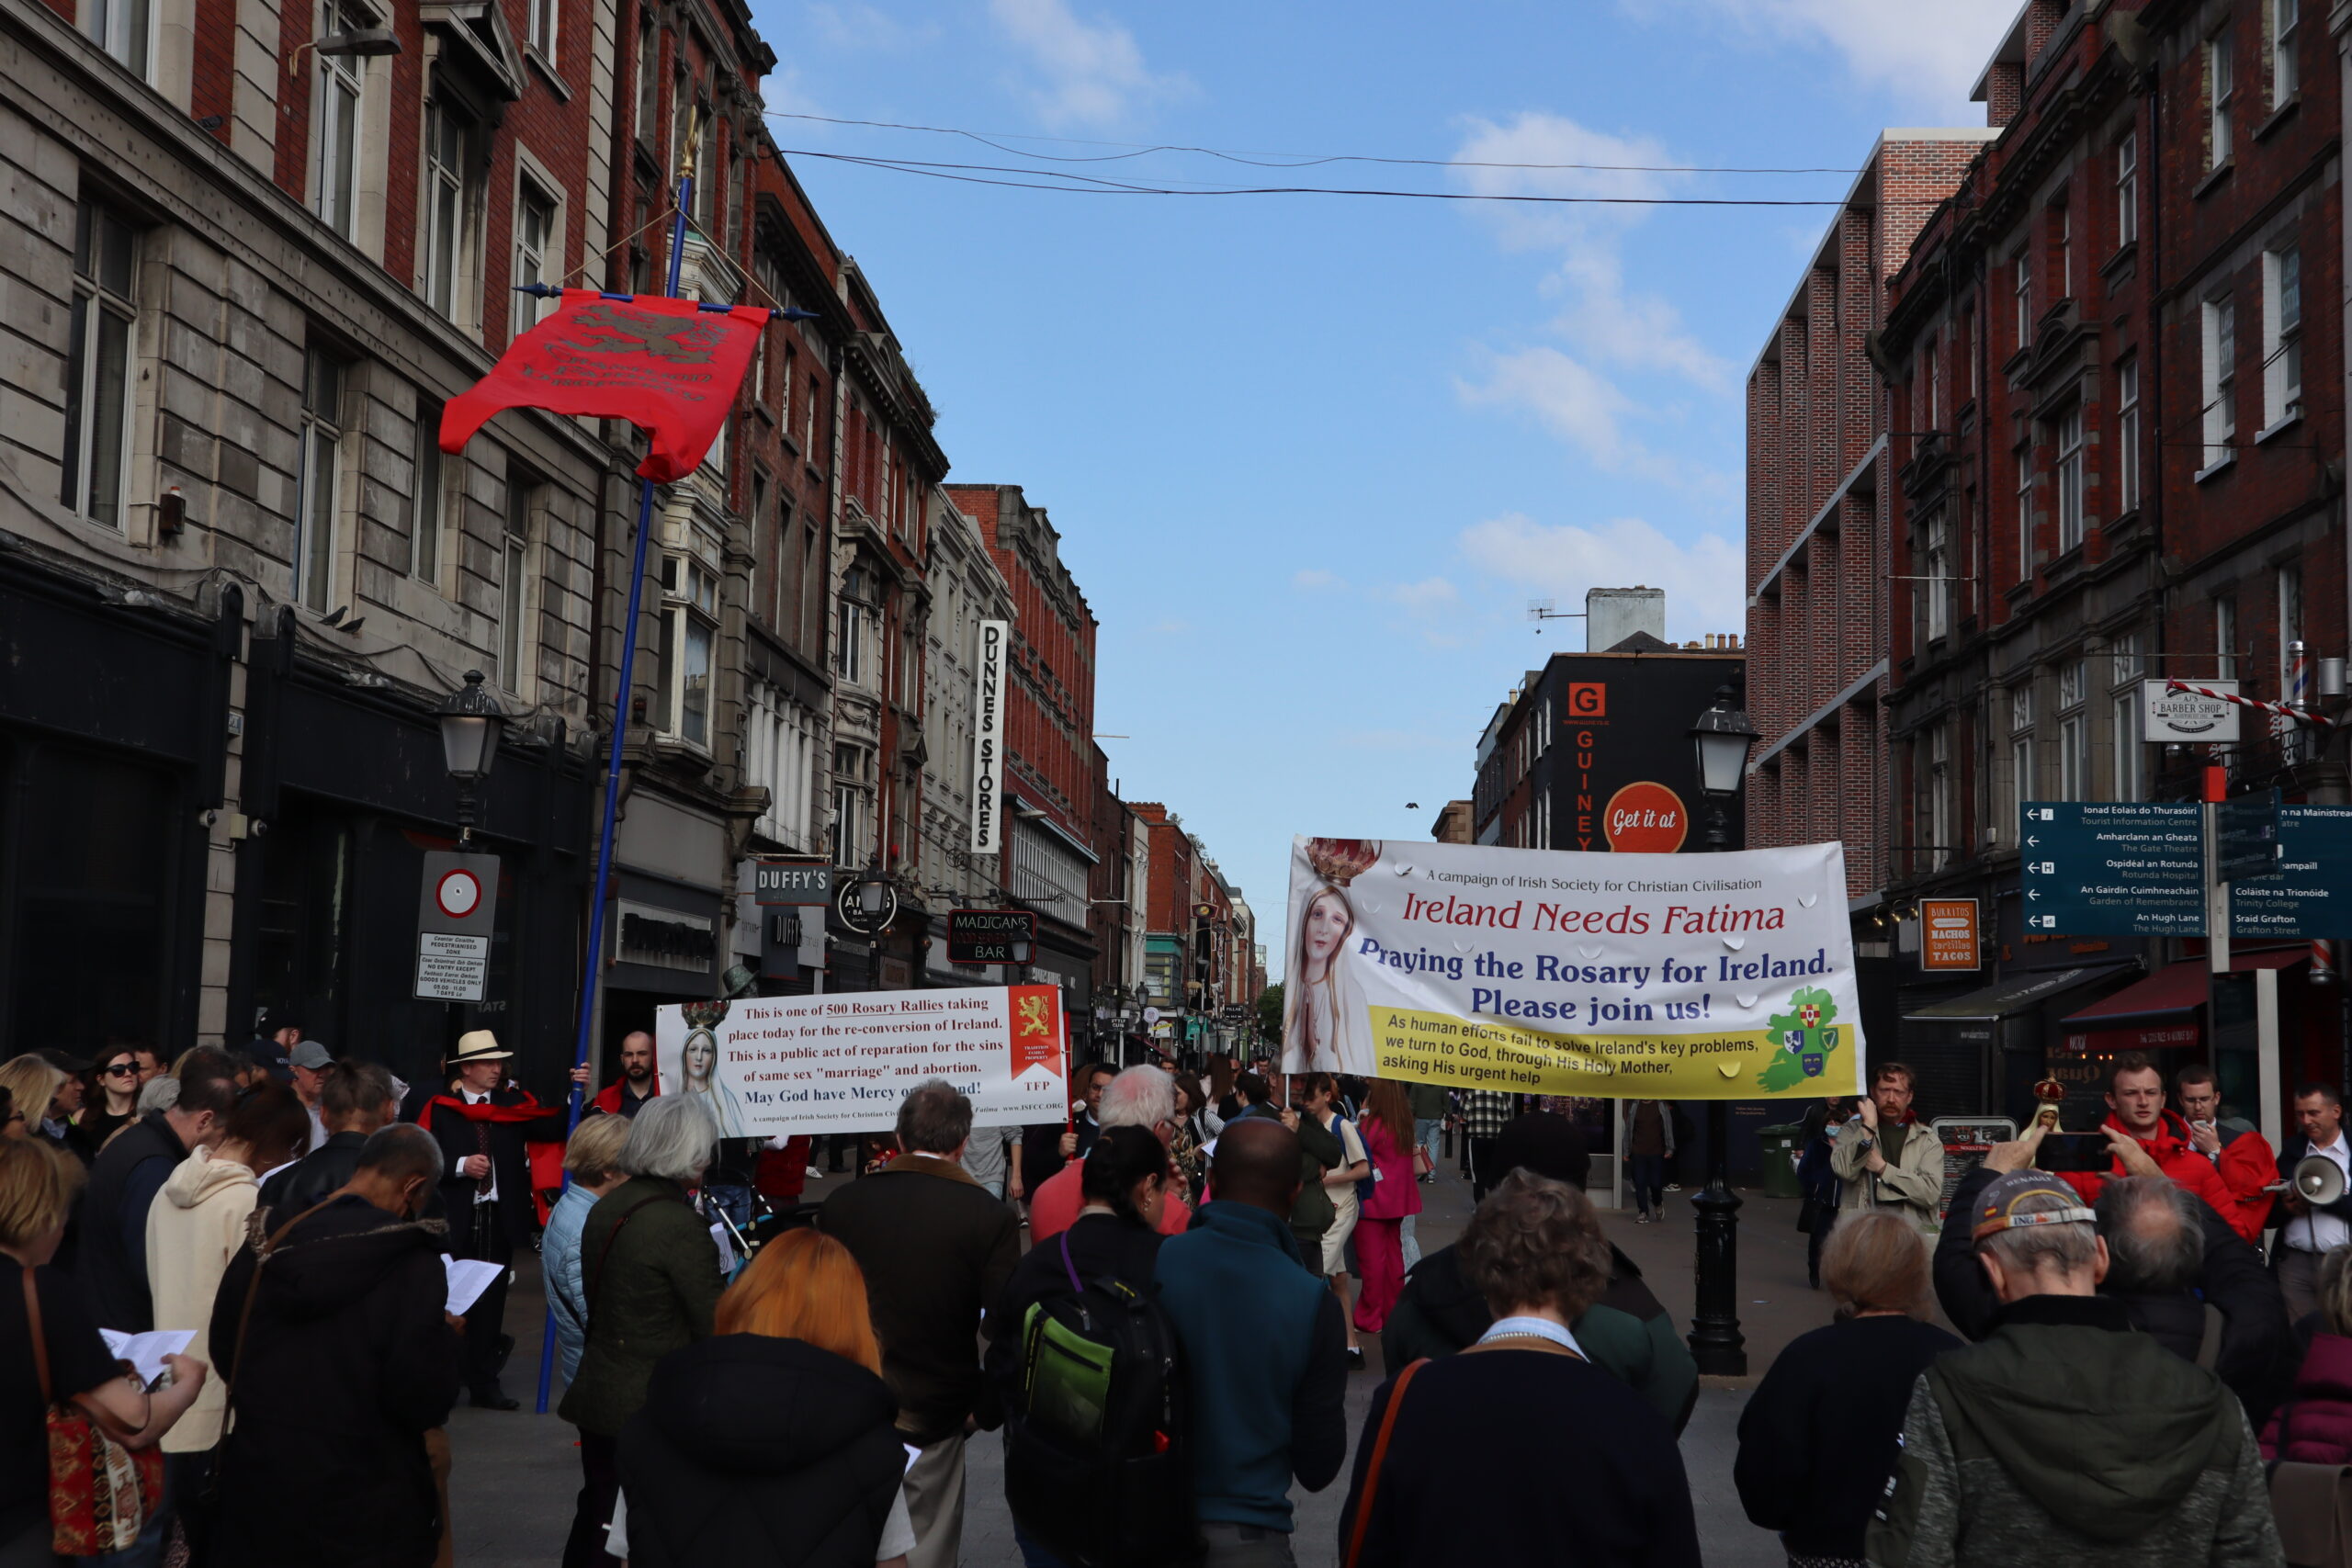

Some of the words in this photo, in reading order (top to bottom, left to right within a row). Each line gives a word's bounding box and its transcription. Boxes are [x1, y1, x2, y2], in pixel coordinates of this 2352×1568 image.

[982, 626, 1000, 732] DUNNES
[1575, 687, 1598, 712] G
[2160, 704, 2196, 713] BARBER
[2199, 705, 2221, 714] SHOP
[978, 739, 993, 847] STORES
[2140, 807, 2151, 815] do
[1613, 808, 1640, 836] Get
[1643, 808, 1657, 829] it
[1659, 810, 1677, 829] at
[2113, 818, 2165, 826] Information
[2165, 833, 2198, 841] Gheata
[2140, 844, 2161, 852] Gate
[2164, 844, 2198, 852] Theatre
[2106, 859, 2144, 869] Ospidéal
[2160, 860, 2198, 868] Rotunda
[758, 870, 826, 889] DUFFY'S
[2121, 871, 2159, 879] Rotunda
[2162, 871, 2199, 880] Hospital
[1427, 870, 1435, 880] A
[1438, 871, 1498, 888] campaign
[1502, 875, 1515, 886] of
[1519, 876, 1547, 888] Irish
[1551, 878, 1600, 894] Society
[1604, 879, 1623, 892] for
[1627, 880, 1689, 893] Christian
[1692, 878, 1762, 891] Civilisation
[2089, 897, 2121, 905] Garden
[2123, 897, 2134, 905] of
[2136, 897, 2199, 906] Remembrance
[2235, 898, 2264, 908] Trinity
[2266, 899, 2300, 909] College
[1402, 892, 1523, 930] Ireland
[1532, 902, 1650, 934] Needs
[1661, 903, 1785, 934] Fatima
[1931, 907, 1970, 917] BURRITOS
[2152, 914, 2176, 923] Hugh
[2178, 914, 2199, 922] Lane
[2261, 915, 2296, 923] Grafton
[1931, 930, 1971, 940] NACHOS
[2152, 925, 2176, 934] Hugh
[2236, 926, 2271, 934] Grafton
[2274, 926, 2301, 935] Street
[430, 942, 477, 950] PEDESTRIANISED
[975, 945, 1005, 958] BAR
[1933, 952, 1972, 961] TACOS
[1358, 937, 1464, 981] Praying
[1474, 951, 1523, 979] the
[1535, 954, 1650, 989] Rosary
[1661, 957, 1707, 983] for
[1718, 947, 1833, 982] Ireland.
[744, 1007, 770, 1020] This
[773, 1006, 783, 1019] is
[786, 1008, 807, 1018] one
[810, 1004, 824, 1016] of
[826, 1003, 848, 1015] 500
[852, 1001, 897, 1015] Rosary
[900, 998, 944, 1012] Rallies
[947, 998, 989, 1011] taking
[1472, 987, 1577, 1020] Please
[1588, 997, 1654, 1026] join
[1665, 993, 1711, 1020] us!
[729, 1027, 759, 1043] place
[763, 1027, 796, 1041] today
[799, 1024, 819, 1037] for
[821, 1023, 842, 1036] the
[844, 1021, 932, 1036] re-conversion
[934, 1018, 948, 1031] of
[951, 1017, 1003, 1030] Ireland.
[1388, 1013, 1406, 1029] As
[1409, 1016, 1458, 1035] human
[1461, 1022, 1507, 1042] efforts
[1510, 1032, 1532, 1047] fail
[1536, 1035, 1550, 1049] to
[1554, 1039, 1591, 1054] solve
[1595, 1040, 1657, 1055] Ireland's
[1660, 1041, 1685, 1057] key
[1690, 1038, 1759, 1056] problems,
[728, 1050, 752, 1063] This
[756, 1049, 766, 1061] is
[770, 1052, 777, 1061] a
[781, 1046, 819, 1063] public
[821, 1047, 842, 1058] act
[844, 1044, 858, 1056] of
[861, 1042, 929, 1058] reparation
[932, 1040, 952, 1054] for
[955, 1040, 976, 1052] the
[978, 1039, 1003, 1051] sins
[1385, 1036, 1405, 1049] we
[1408, 1037, 1436, 1053] turn
[1441, 1040, 1454, 1055] to
[1458, 1042, 1491, 1061] God,
[1496, 1047, 1553, 1069] through
[1556, 1055, 1579, 1071] His
[1583, 1058, 1616, 1077] Holy
[1621, 1060, 1673, 1075] Mother,
[743, 1070, 757, 1082] of
[759, 1072, 790, 1082] same
[793, 1071, 813, 1080] sex
[817, 1064, 890, 1080] "marriage"
[894, 1062, 919, 1076] and
[922, 1061, 982, 1076] abortion.
[1382, 1055, 1429, 1075] asking
[1432, 1059, 1456, 1075] His
[1460, 1066, 1507, 1081] urgent
[1510, 1068, 1541, 1087] help
[1024, 1080, 1050, 1091] TFP
[744, 1090, 775, 1106] May
[779, 1088, 808, 1102] God
[813, 1087, 846, 1101] have
[851, 1085, 897, 1101] Mercy
[1002, 1102, 1064, 1112] www.ISFCC.ORG
[759, 1115, 790, 1123] campaign
[852, 1111, 884, 1119] Christian
[2014, 1216, 2035, 1225] ING
